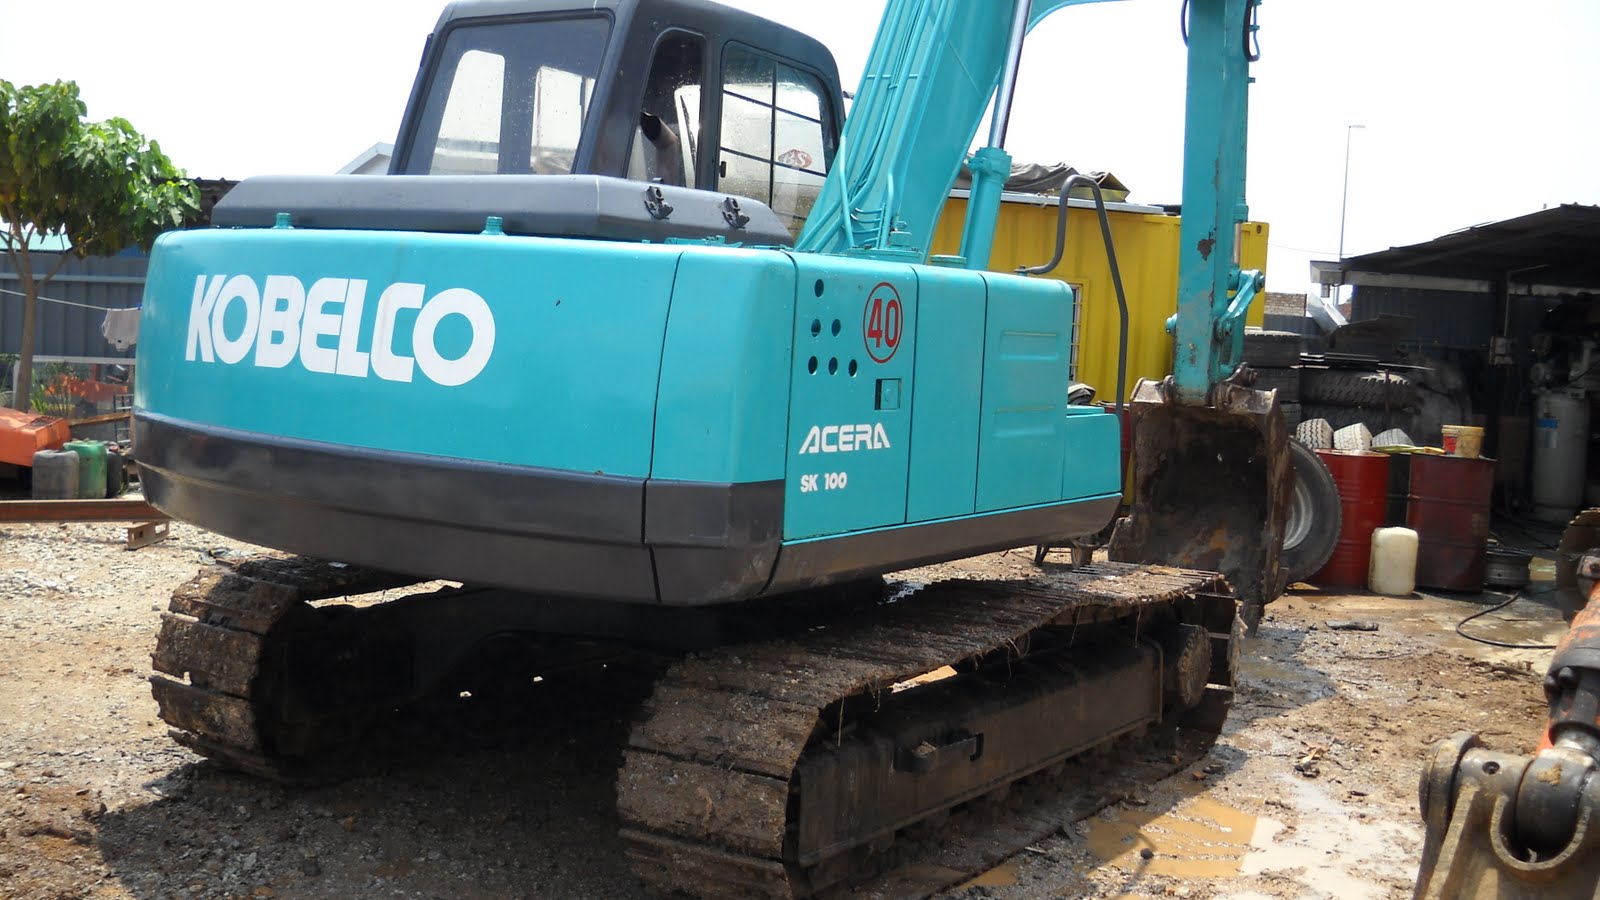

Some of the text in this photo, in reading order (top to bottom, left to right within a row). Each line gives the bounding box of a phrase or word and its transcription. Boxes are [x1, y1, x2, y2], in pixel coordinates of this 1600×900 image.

[185, 274, 496, 386] KOBELCO
[867, 298, 899, 347] 40
[799, 422, 890, 454] ACERA
[800, 472, 847, 492] SK 100
